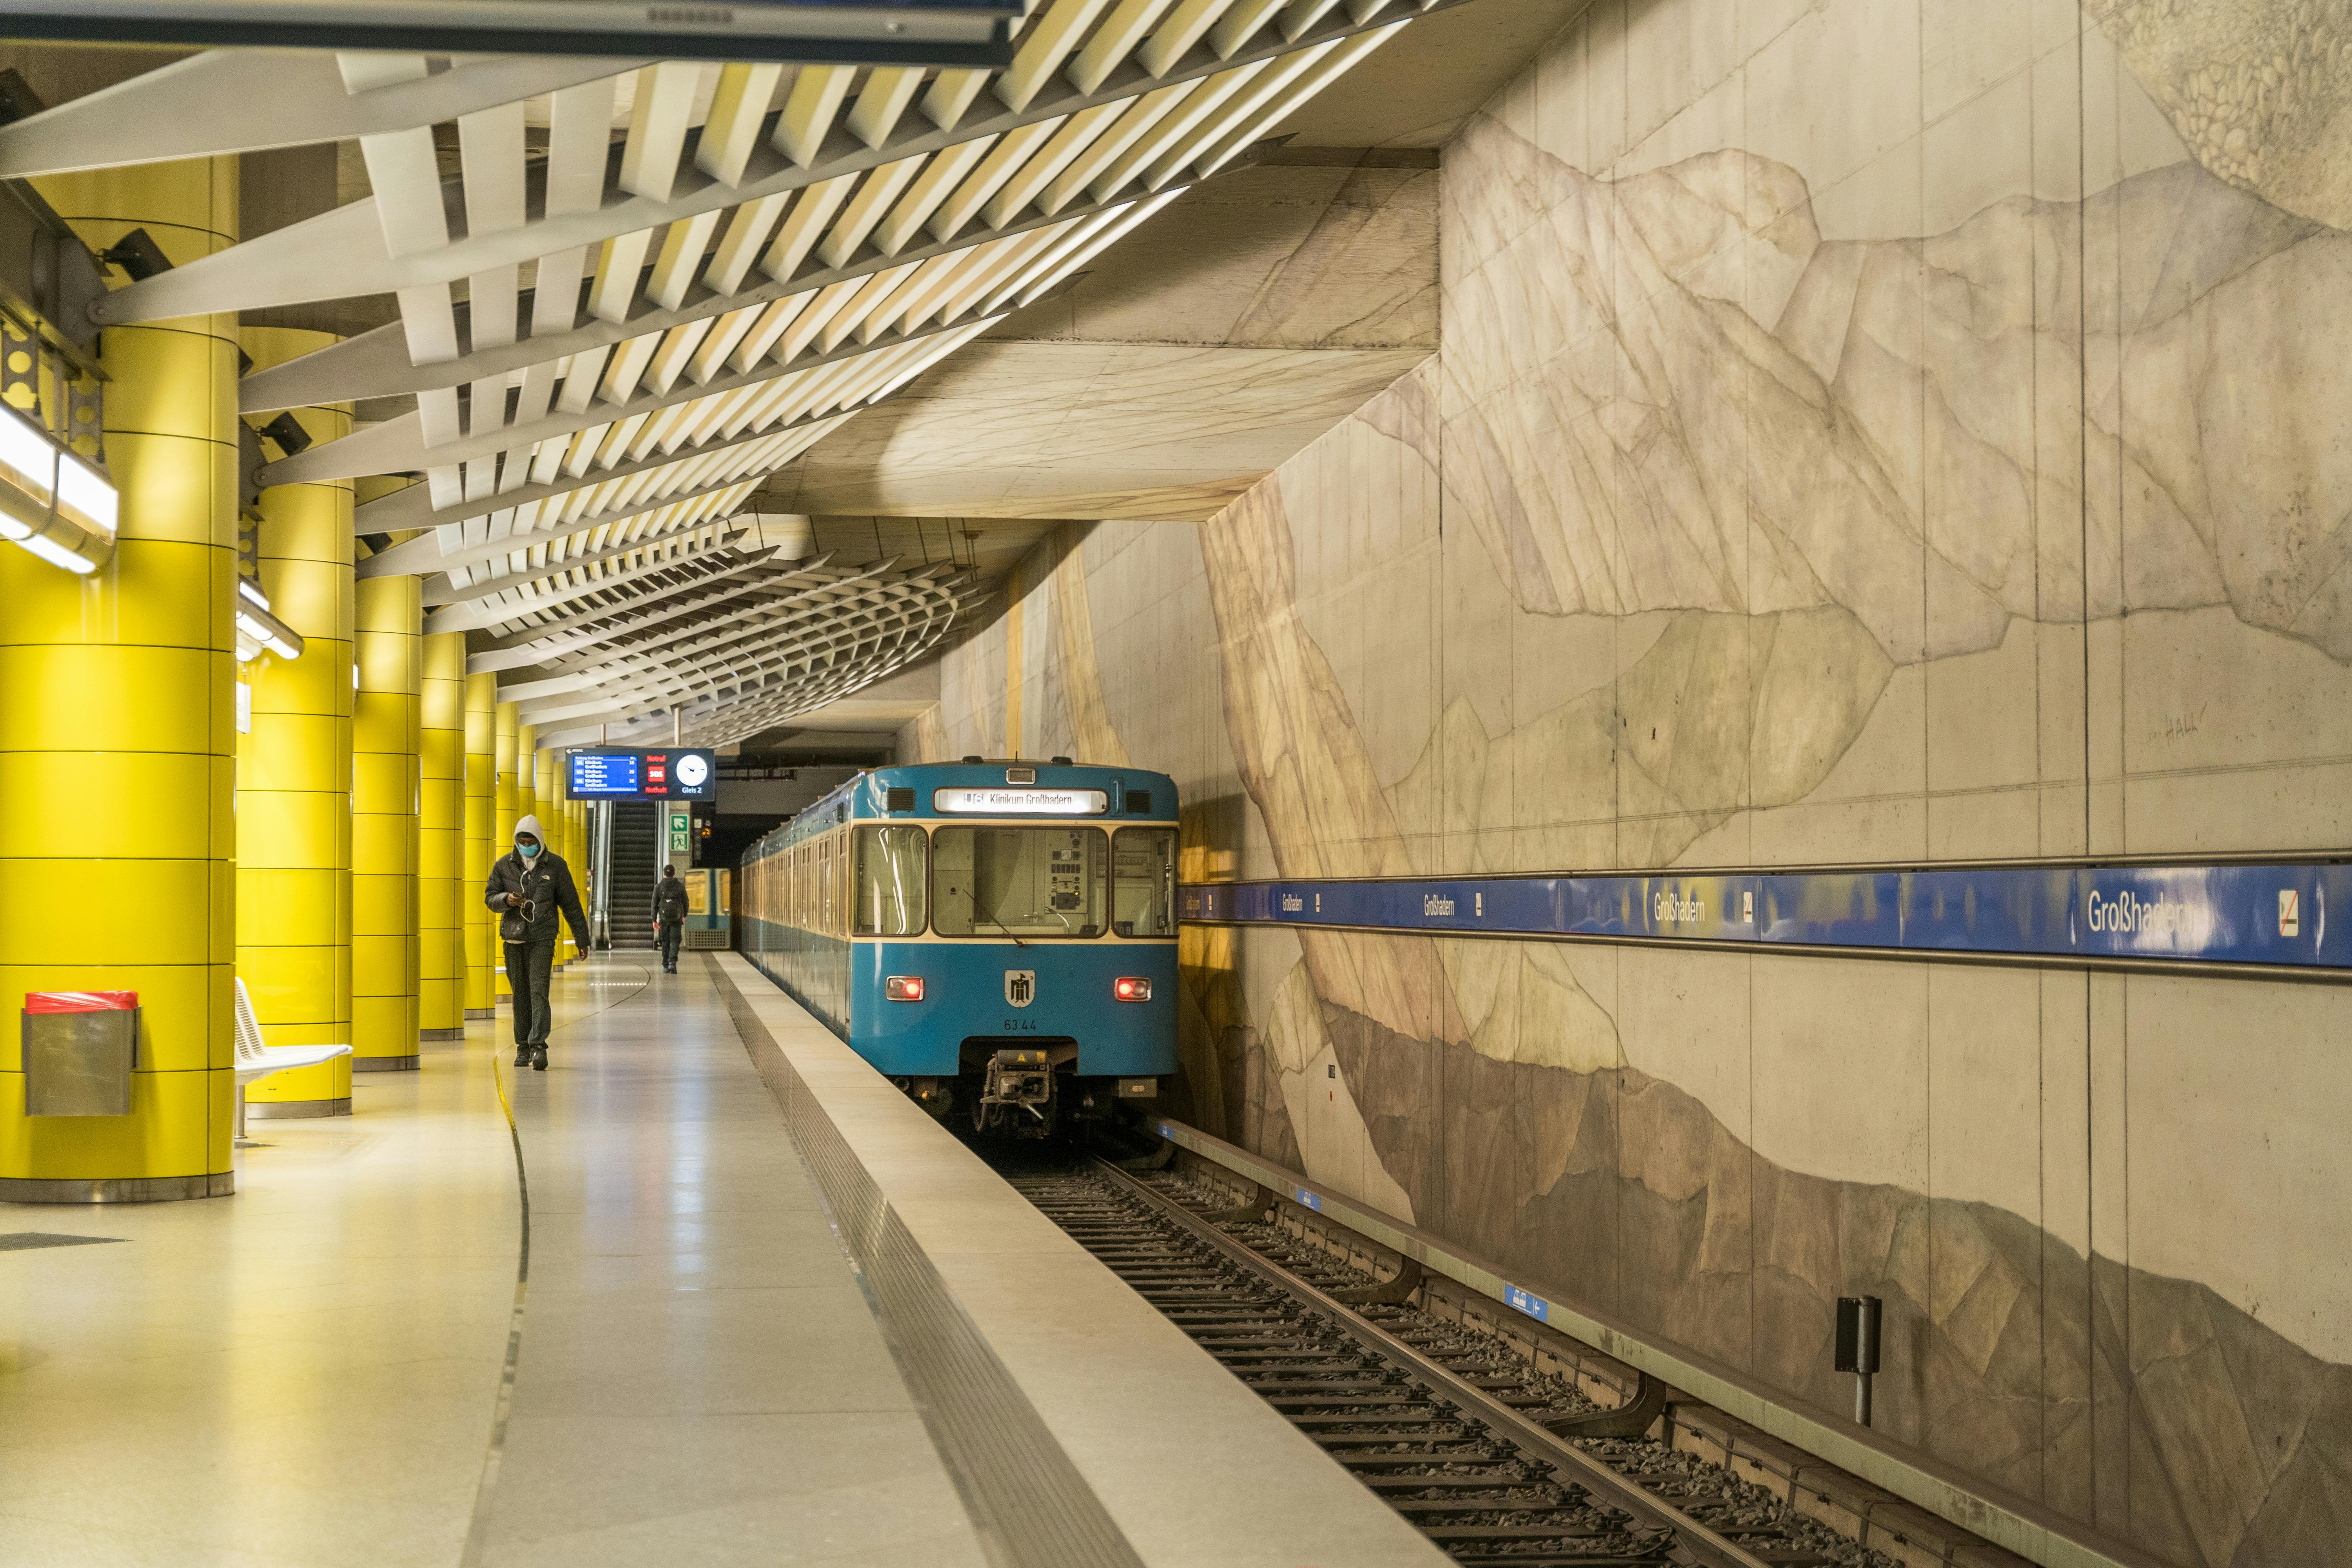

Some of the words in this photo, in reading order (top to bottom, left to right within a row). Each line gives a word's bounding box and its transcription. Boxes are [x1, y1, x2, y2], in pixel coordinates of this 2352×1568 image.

[990, 794, 1023, 804] Klinikum
[1026, 794, 1072, 804] Großhadern
[1424, 894, 1454, 916] Großhadern
[1654, 892, 1705, 921] Großhadern
[2089, 890, 2195, 932] Großhadern
